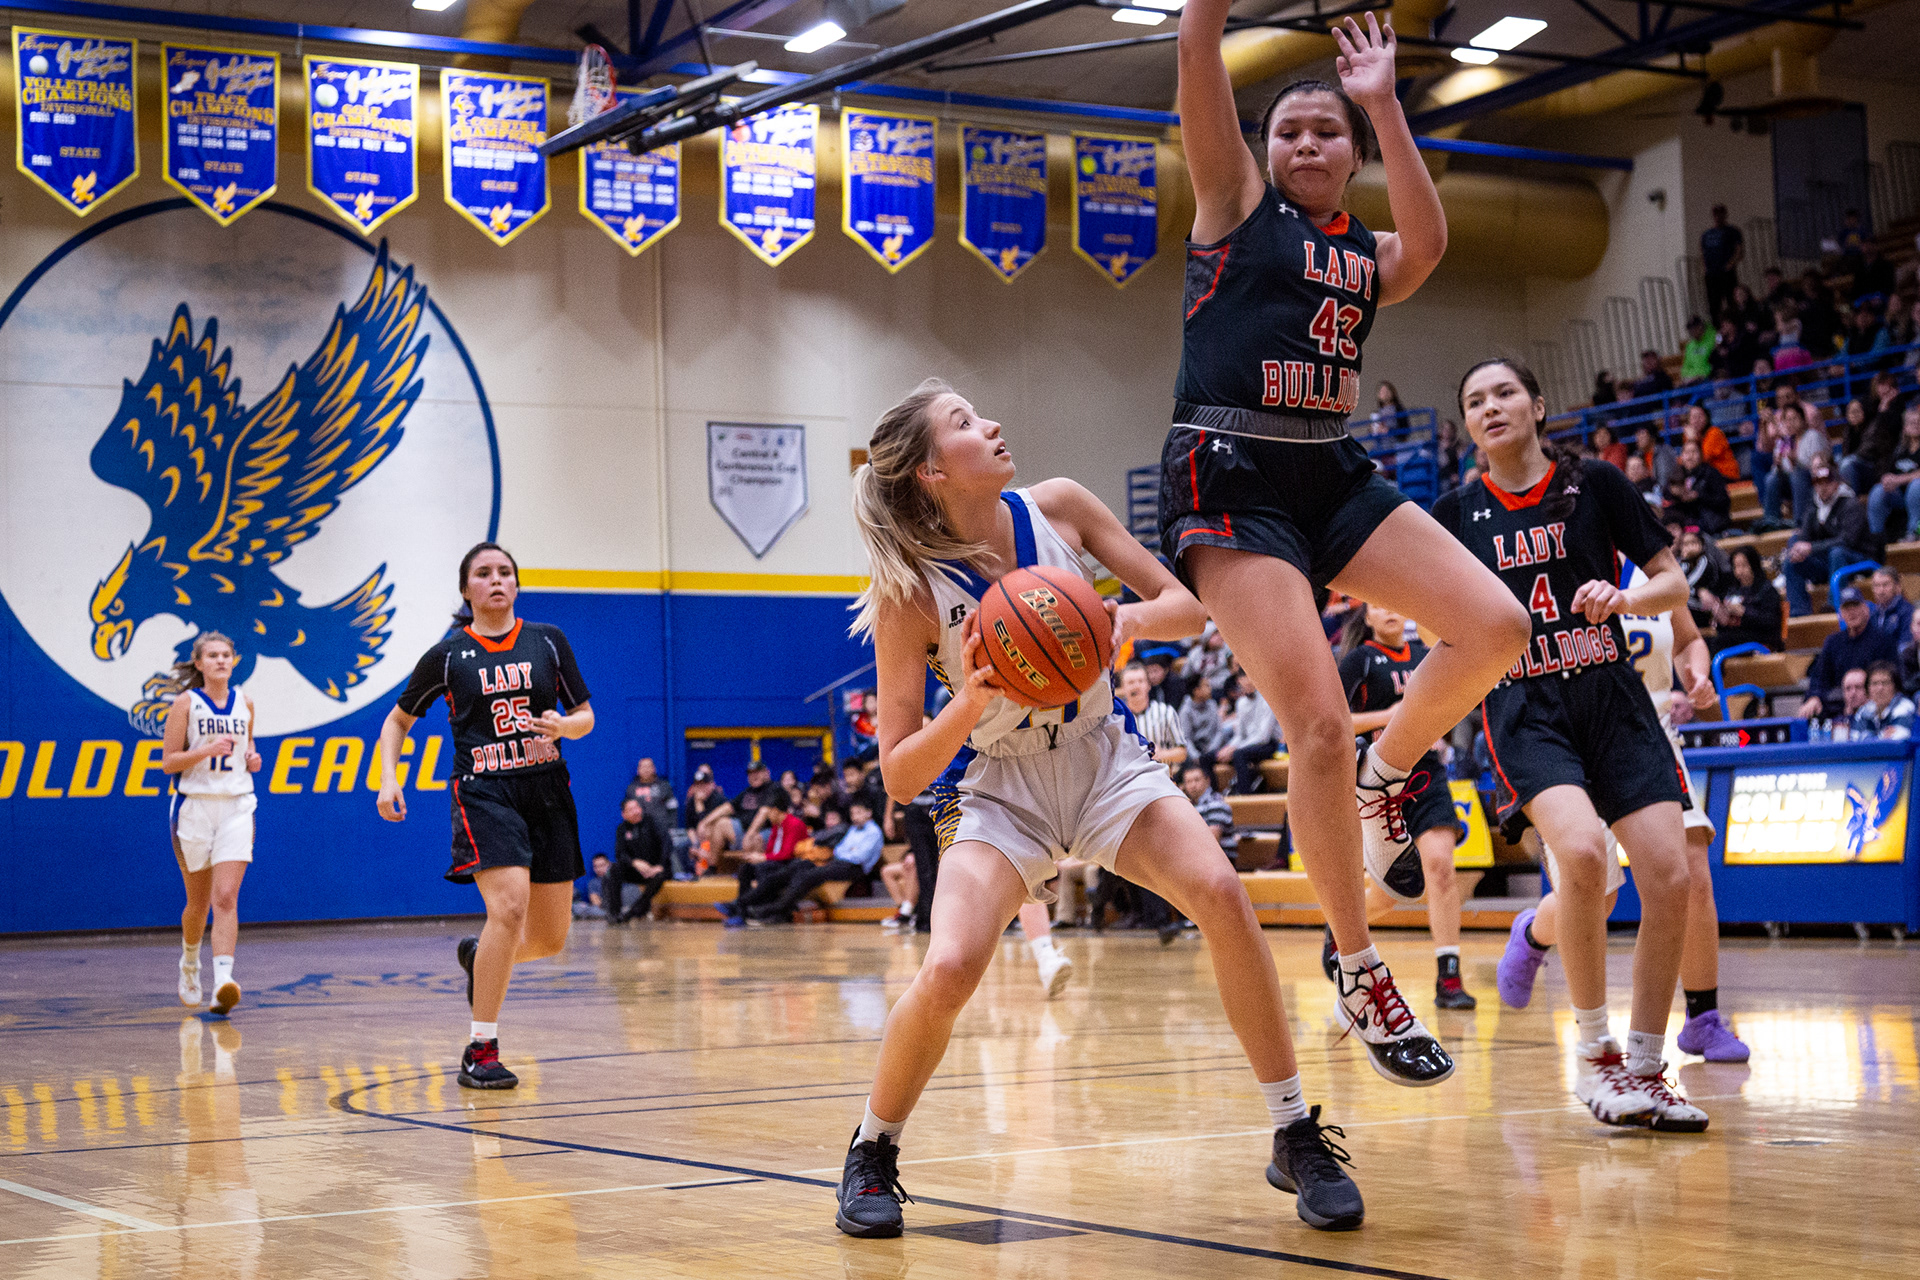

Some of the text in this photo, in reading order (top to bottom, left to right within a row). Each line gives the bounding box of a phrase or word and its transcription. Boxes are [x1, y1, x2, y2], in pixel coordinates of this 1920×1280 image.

[22, 87, 131, 111] CHAMPIONS
[24, 76, 129, 95] VOLLEYBALL
[194, 91, 249, 106] TRACK
[170, 99, 274, 125] CHAMPIONS
[313, 112, 412, 138] CHAMPIONS
[60, 146, 101, 159] STATE
[204, 160, 244, 174] STATE
[1304, 241, 1375, 301] LADY
[1309, 297, 1362, 360] 43
[1493, 522, 1567, 571] LADY
[1529, 573, 1560, 623] 4
[1018, 587, 1087, 669] Baden
[993, 616, 1050, 690] ELITE
[478, 662, 532, 695] LADY
[198, 718, 245, 735] EAGLES
[491, 696, 532, 737] 25
[268, 735, 448, 794] EAGL
[1731, 790, 1845, 822] GOLDEN
[1728, 821, 1837, 853] EAGLES
